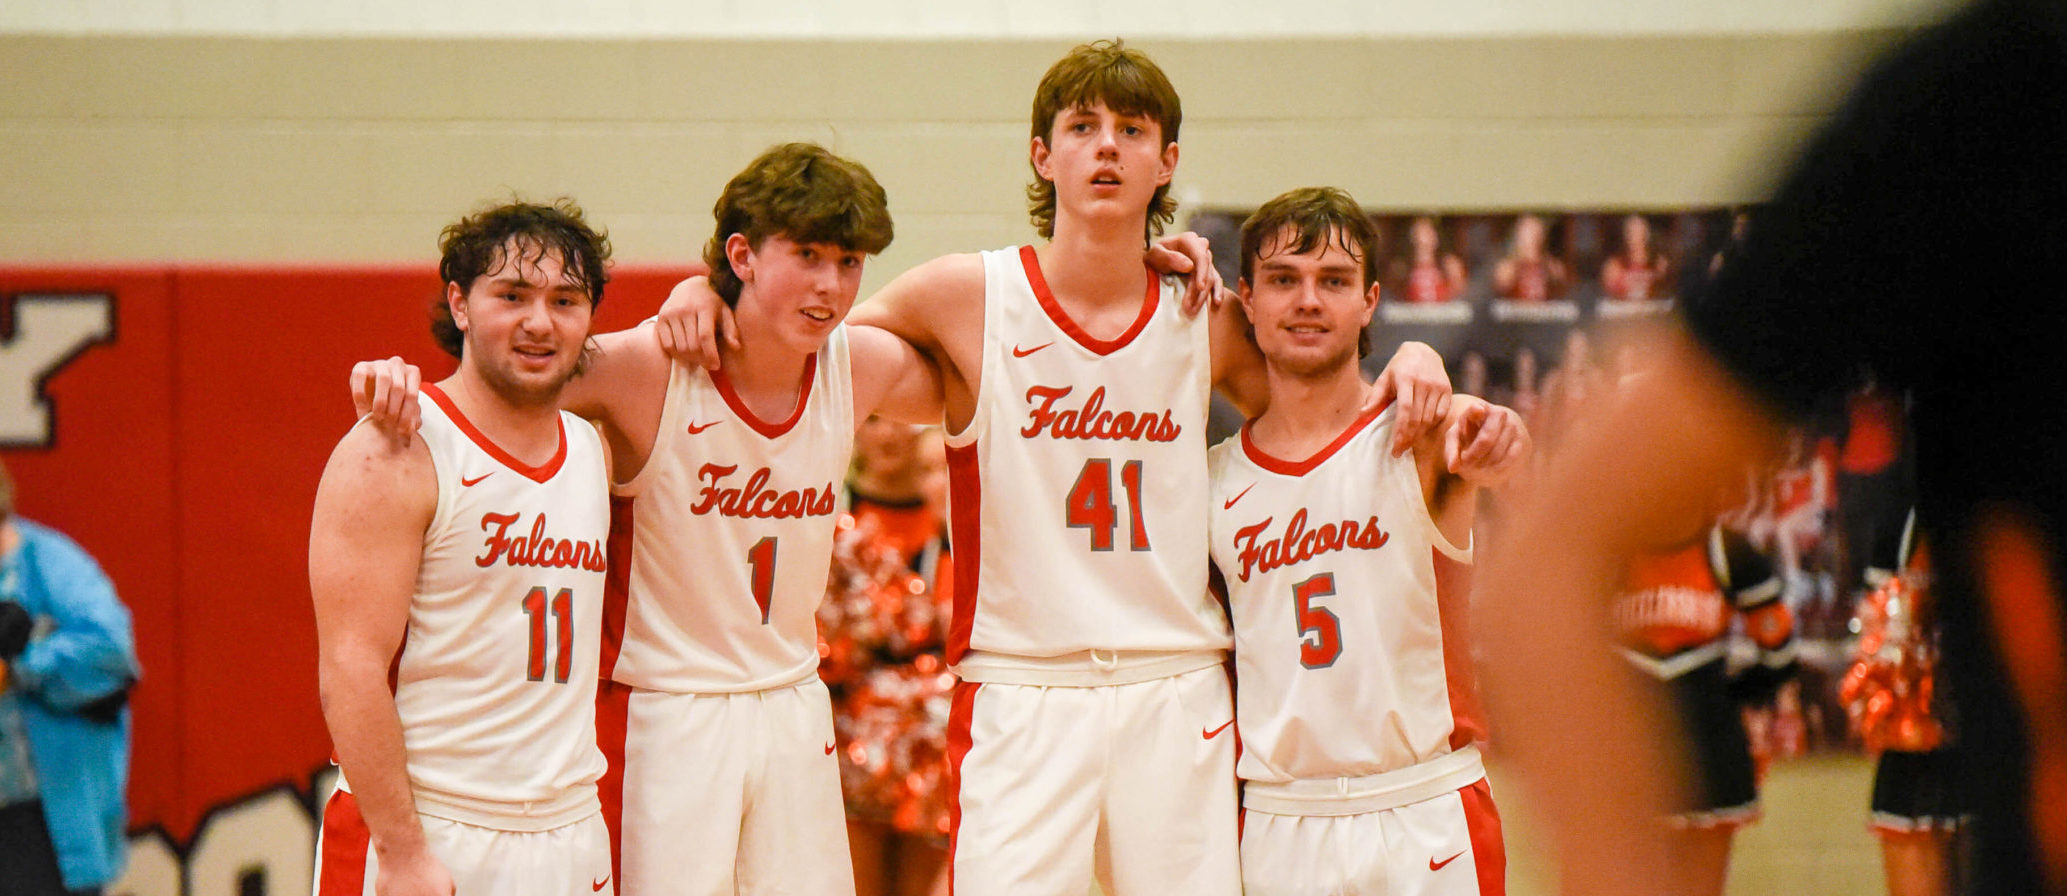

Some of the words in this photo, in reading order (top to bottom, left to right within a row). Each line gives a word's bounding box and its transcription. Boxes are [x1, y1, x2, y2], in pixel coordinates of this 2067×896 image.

[1020, 385, 1181, 442] Falcons
[690, 463, 835, 519] Falcons
[1065, 458, 1152, 552] 41
[475, 512, 607, 572] Falcons
[747, 536, 778, 625] 1
[1233, 507, 1389, 583] Falcons
[522, 586, 573, 684] 11
[1292, 572, 1343, 670] 5
